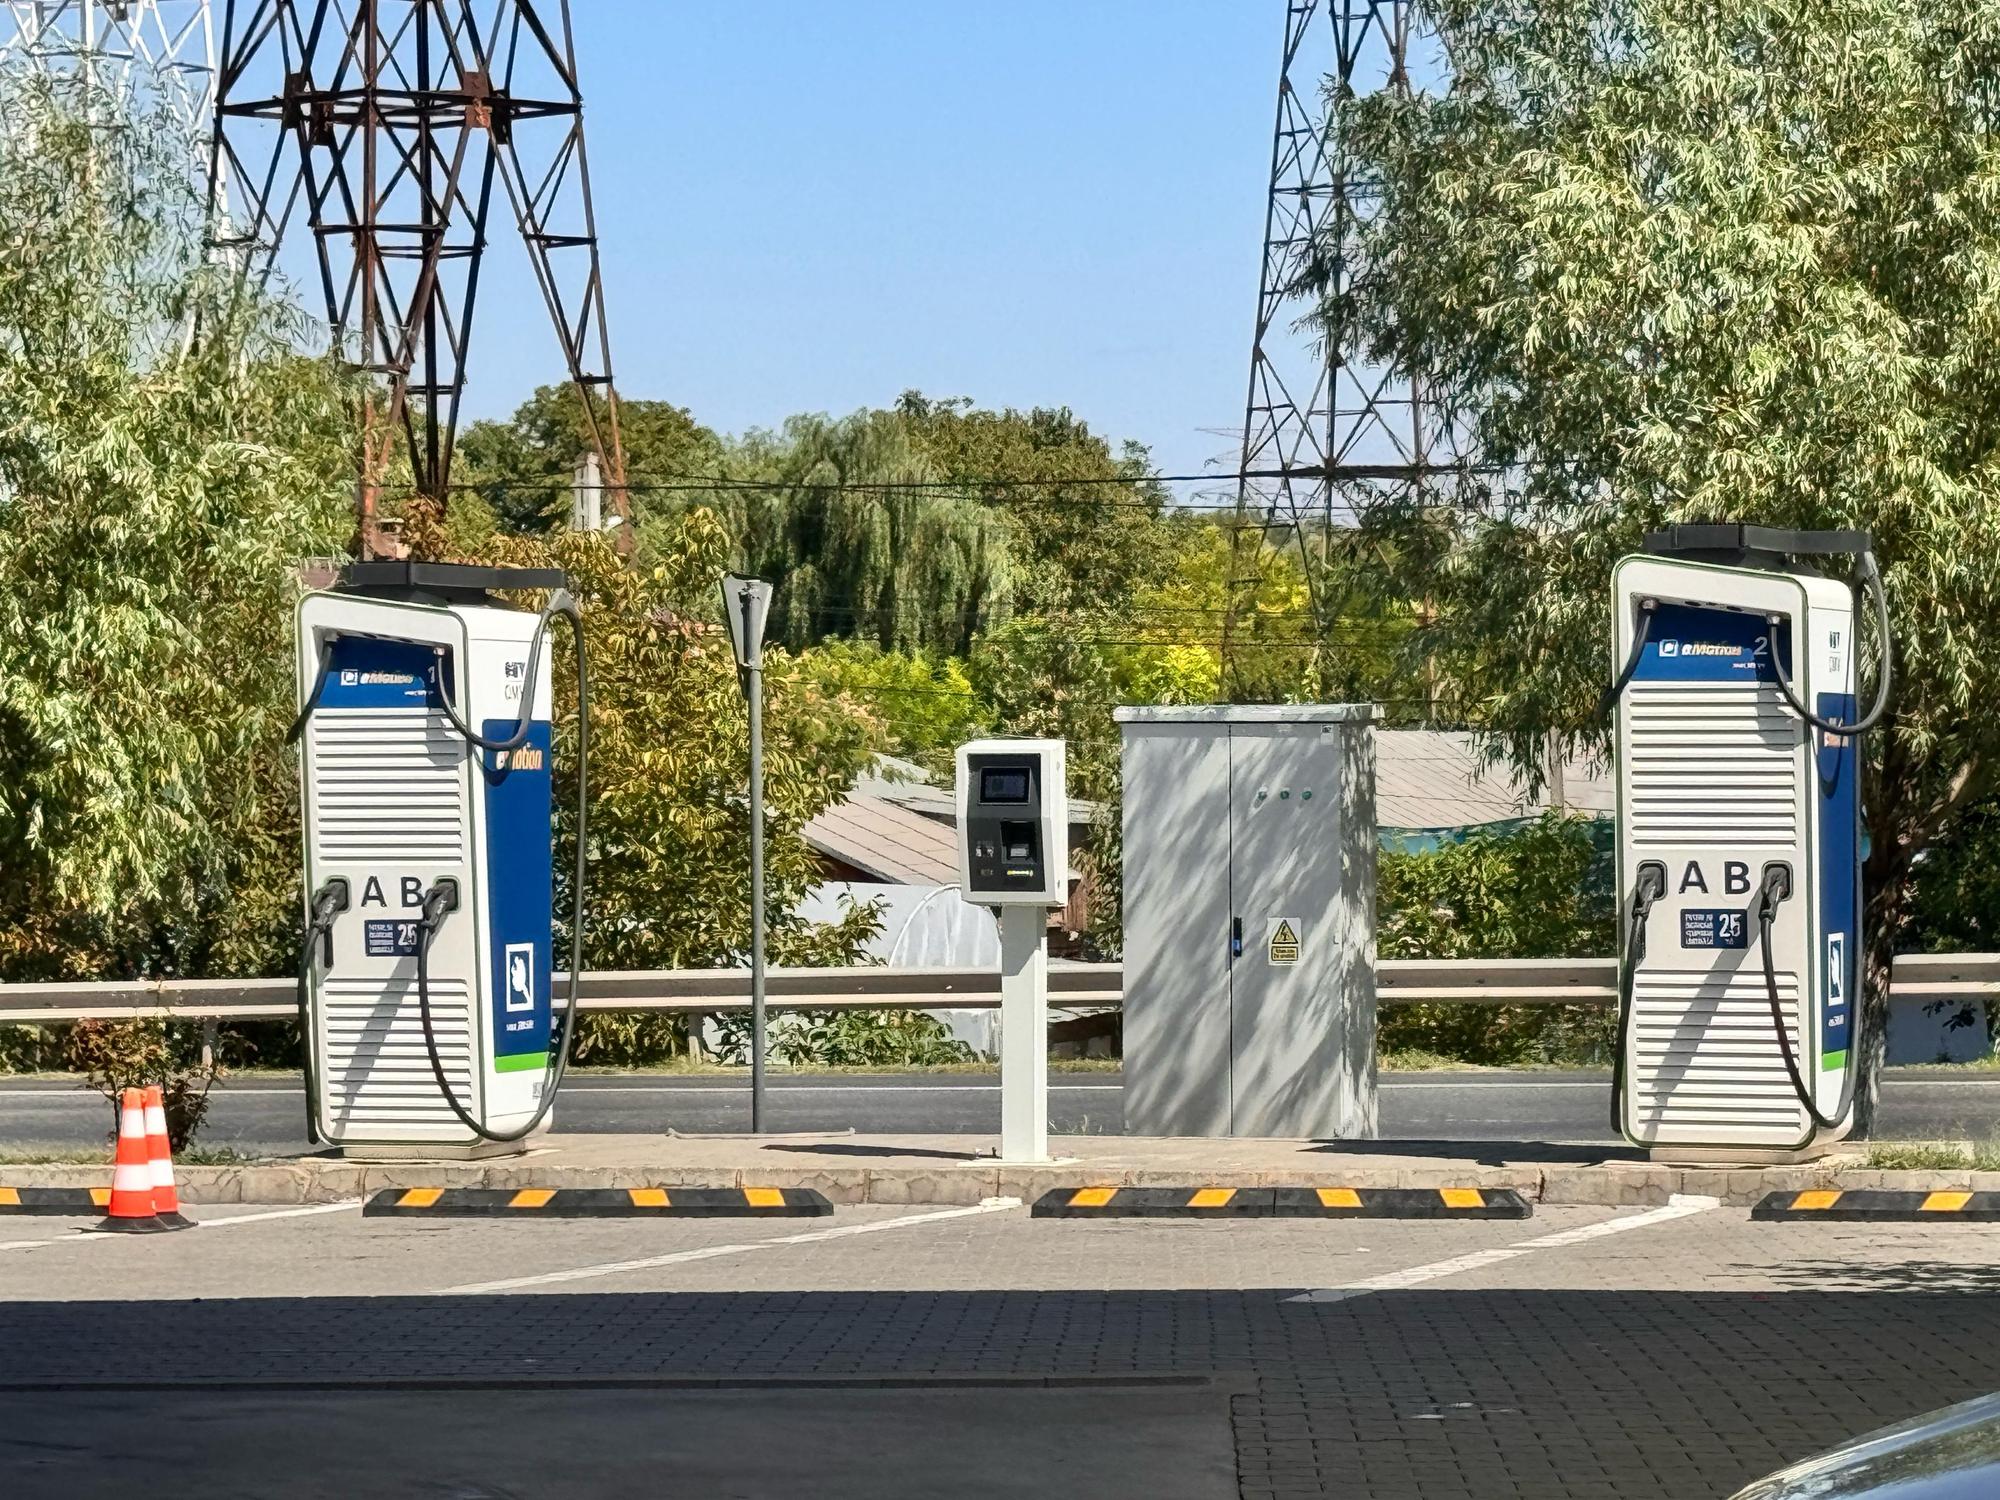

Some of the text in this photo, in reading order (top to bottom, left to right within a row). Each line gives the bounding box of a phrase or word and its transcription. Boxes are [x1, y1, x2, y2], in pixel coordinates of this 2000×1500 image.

[1754, 636, 1768, 655] 2
[361, 875, 426, 908] A B
[1679, 860, 1750, 894] A B
